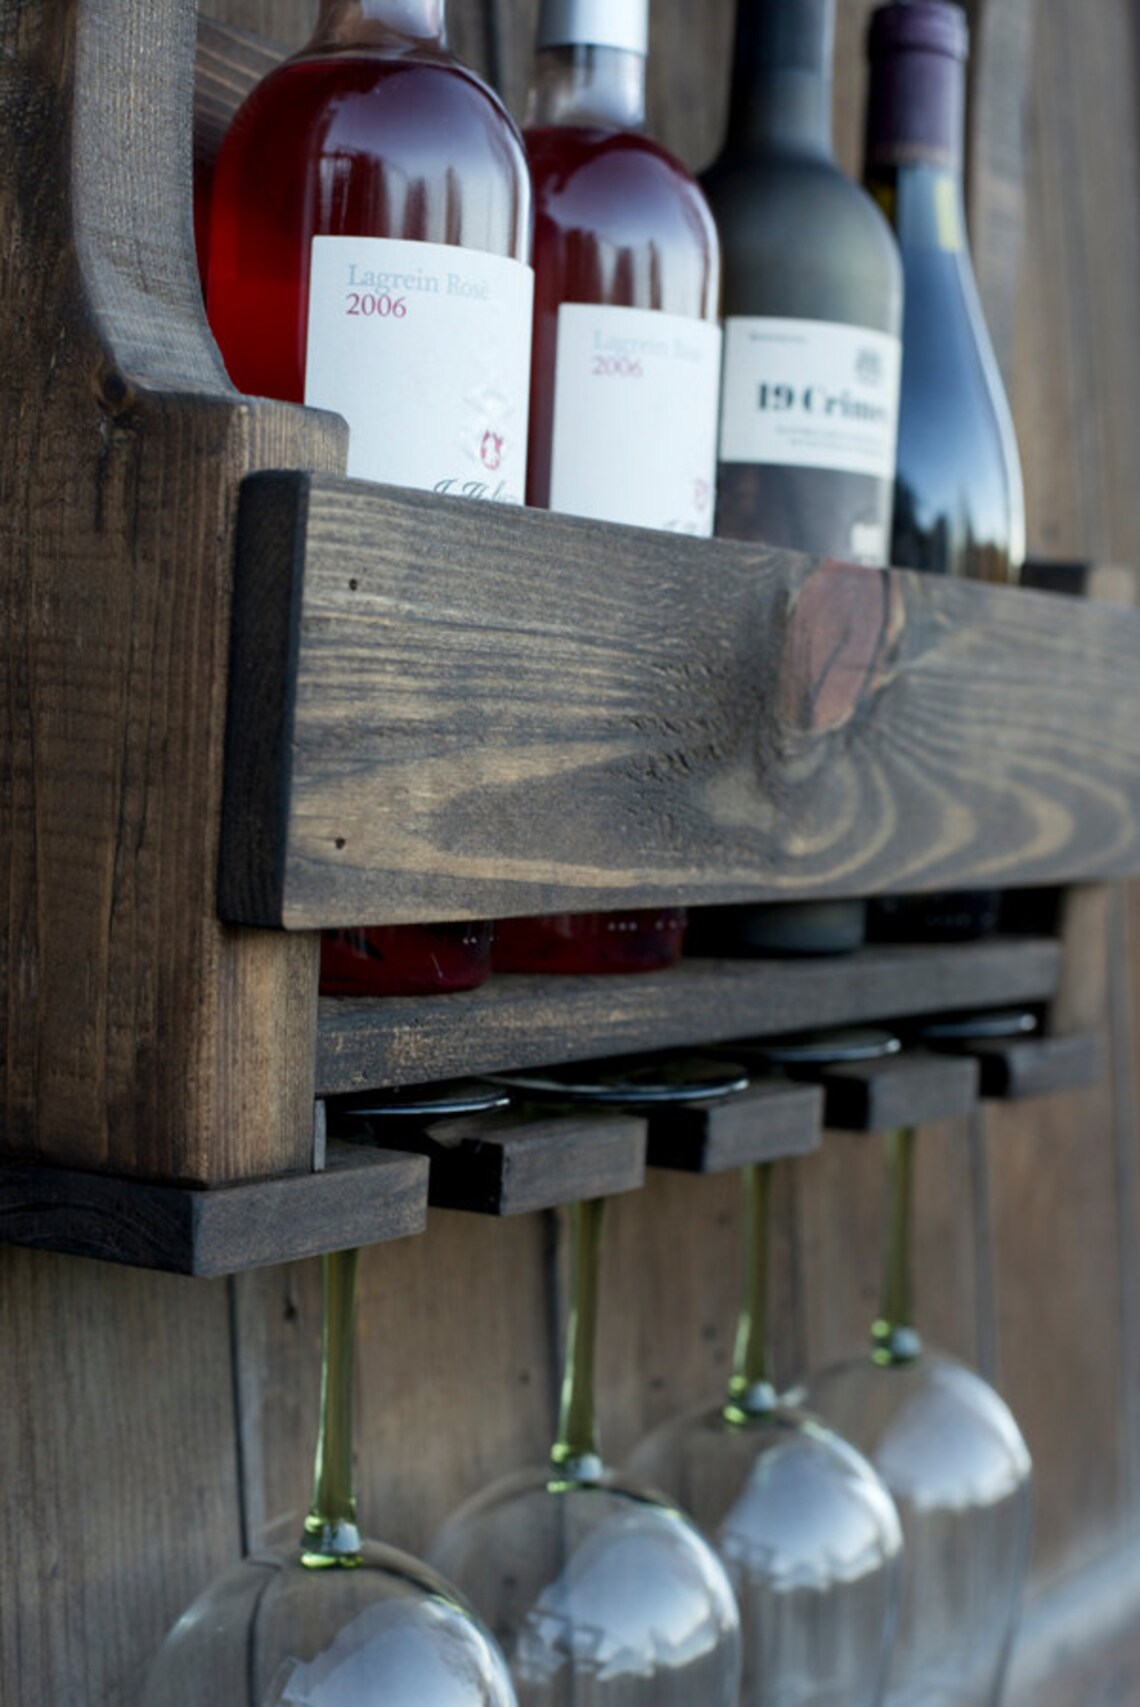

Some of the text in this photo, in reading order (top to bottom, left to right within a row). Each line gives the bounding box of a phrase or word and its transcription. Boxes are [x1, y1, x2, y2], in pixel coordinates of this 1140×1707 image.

[347, 263, 440, 295] Lagrein
[345, 292, 407, 319] 2006
[591, 354, 645, 379] 2006
[759, 383, 794, 411] 19
